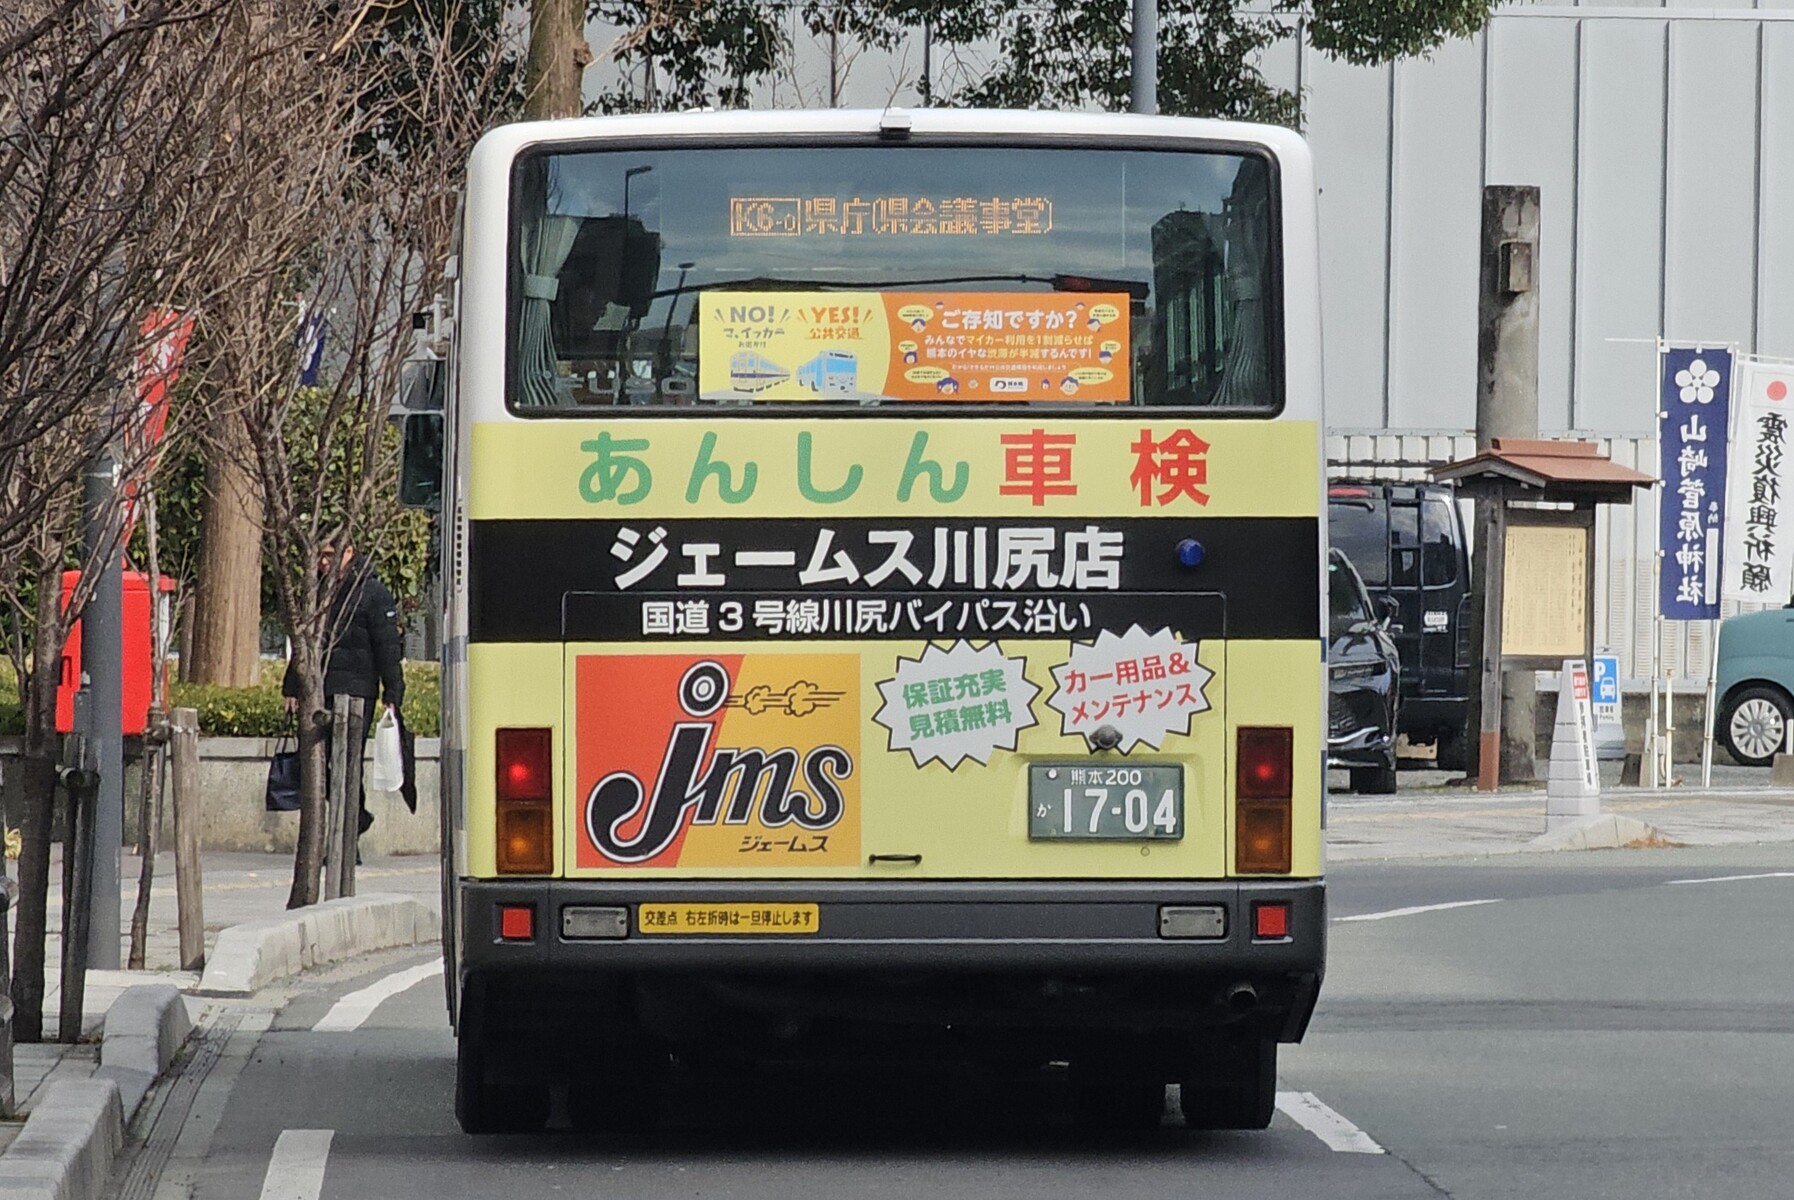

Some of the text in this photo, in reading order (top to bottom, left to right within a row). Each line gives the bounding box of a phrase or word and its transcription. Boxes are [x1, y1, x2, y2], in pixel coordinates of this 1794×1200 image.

[730, 305, 775, 324] NO!
[811, 306, 860, 324] YES!
[941, 308, 1077, 330] ご存知ですか?
[809, 326, 860, 339] 公共交通
[609, 525, 1124, 591] ジェームス川尻店
[641, 598, 1091, 635] 国道3号線川尻バイパス沿い
[1064, 651, 1191, 695] カー用品&
[1594, 660, 1606, 683] P
[902, 667, 1007, 710] 保証充実
[909, 698, 1013, 741] 見積無料
[1070, 683, 1198, 726] メンテナンス
[1036, 788, 1177, 834] か 17-04
[738, 834, 830, 853] ジェームス
[644, 910, 813, 927] 交差点 右左折時は一旦停止します
